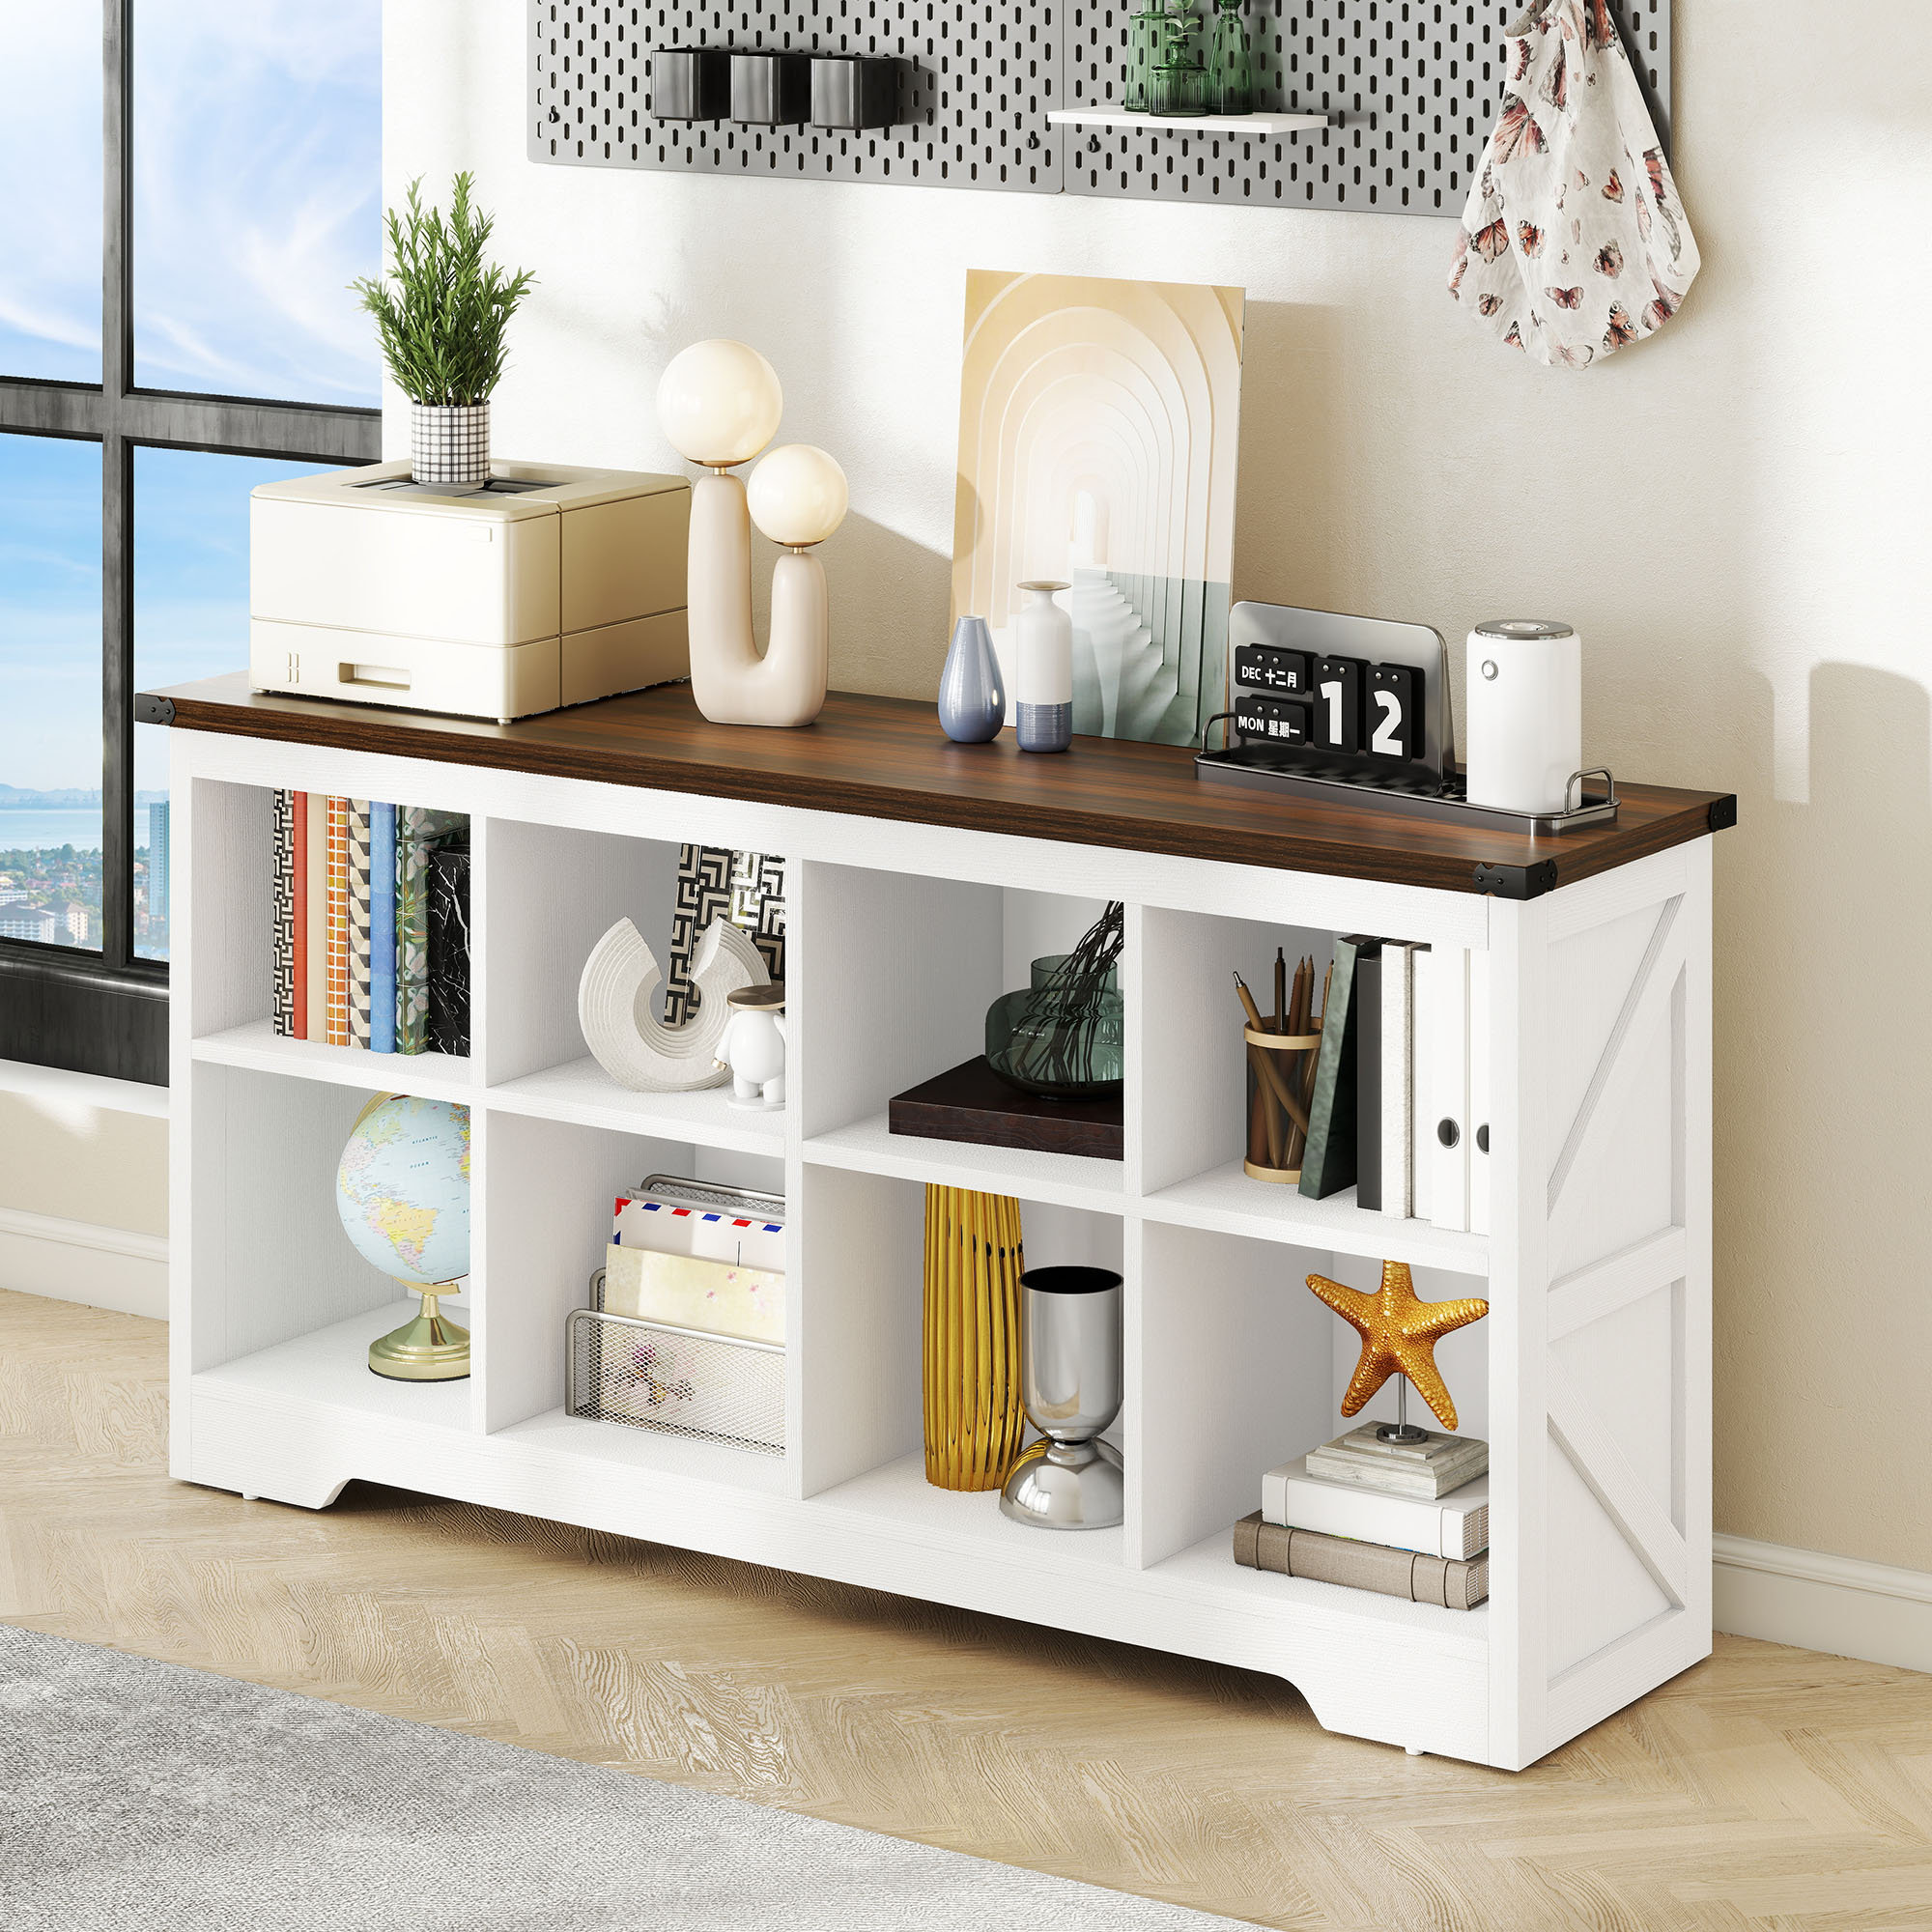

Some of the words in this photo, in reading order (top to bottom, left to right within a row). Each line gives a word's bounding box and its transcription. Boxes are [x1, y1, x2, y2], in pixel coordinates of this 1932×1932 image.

[1242, 666, 1261, 680] DEC
[1265, 668, 1296, 688] 十二月
[1238, 716, 1264, 731] MON
